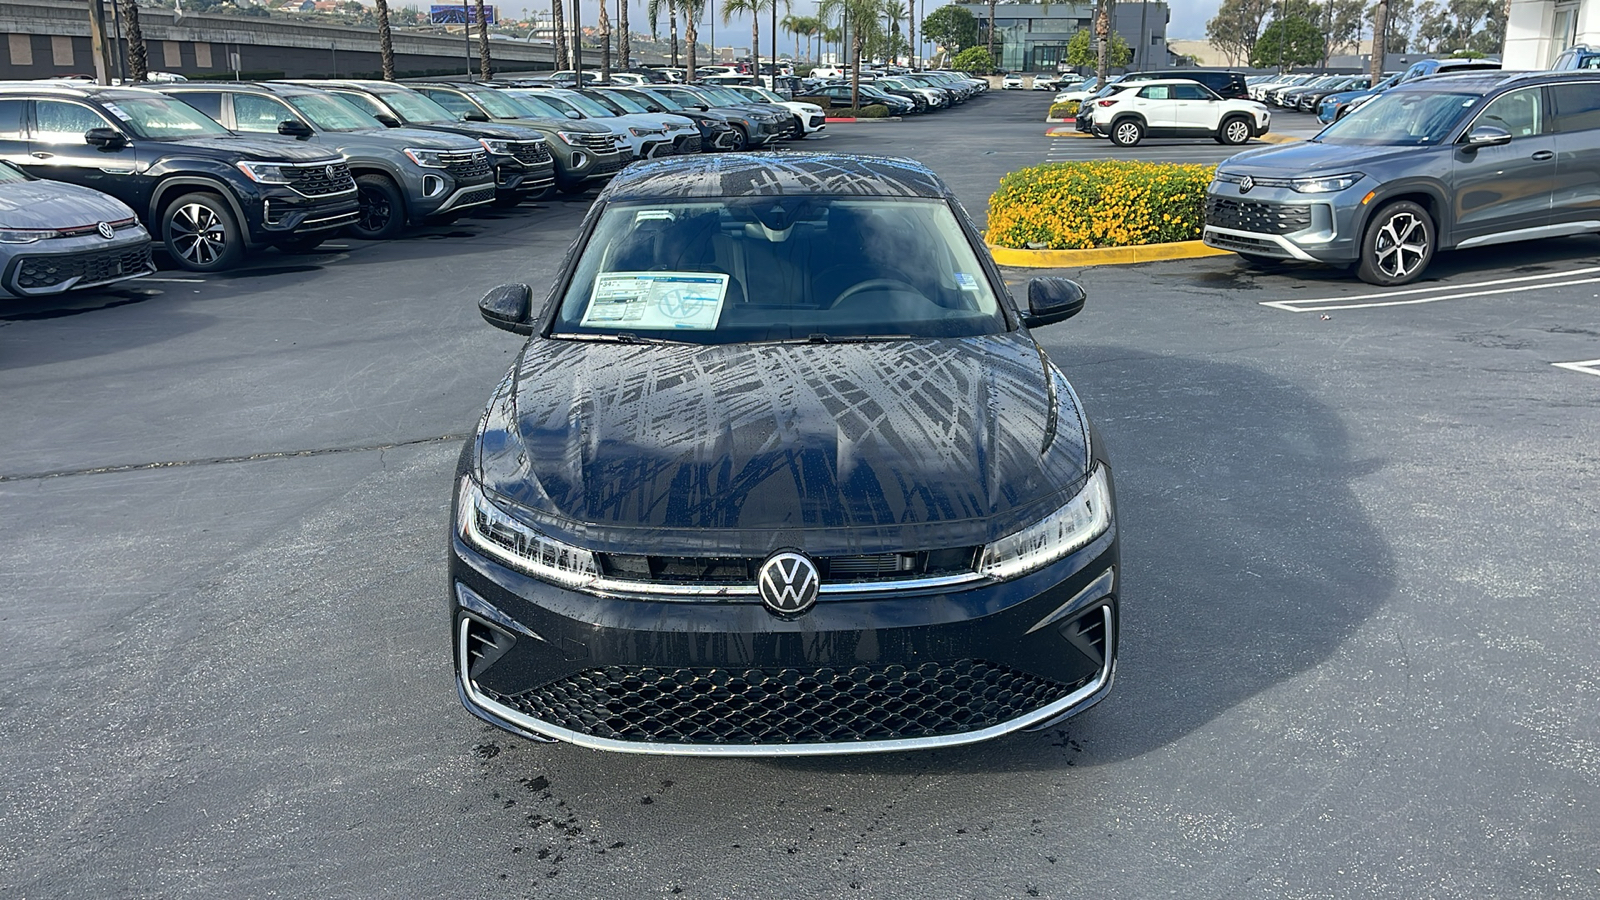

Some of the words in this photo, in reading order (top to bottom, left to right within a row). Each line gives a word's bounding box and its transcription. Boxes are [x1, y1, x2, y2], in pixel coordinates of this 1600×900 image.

[99, 222, 114, 238] VW
[661, 289, 703, 317] VW
[761, 554, 816, 610] VW
